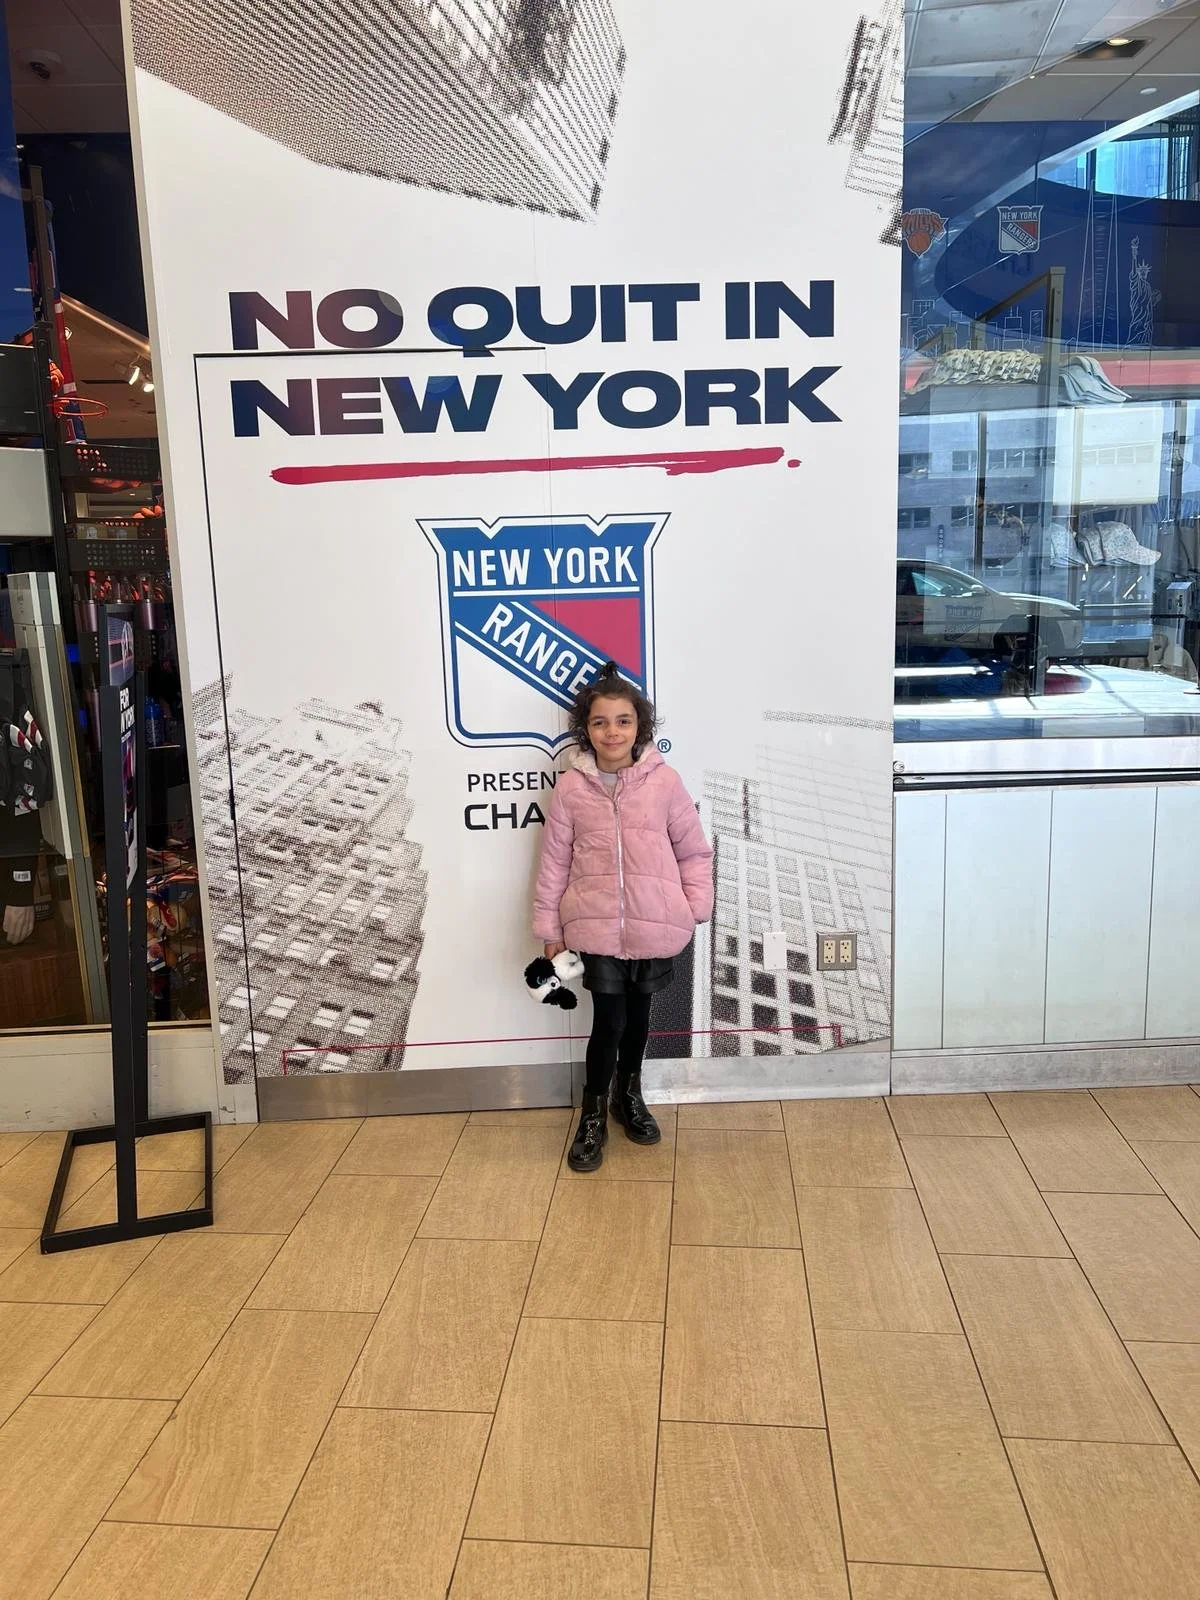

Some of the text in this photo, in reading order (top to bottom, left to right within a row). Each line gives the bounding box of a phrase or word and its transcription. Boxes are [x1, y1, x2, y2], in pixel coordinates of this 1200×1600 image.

[1002, 211, 1038, 220] NEW YORK
[1007, 222, 1036, 249] RANGERS
[228, 279, 835, 358] NO QUIT IN
[230, 365, 843, 438] NEW YORK
[453, 545, 638, 587] NEW YORK
[481, 601, 598, 696] RANGE
[464, 802, 546, 831] CHA
